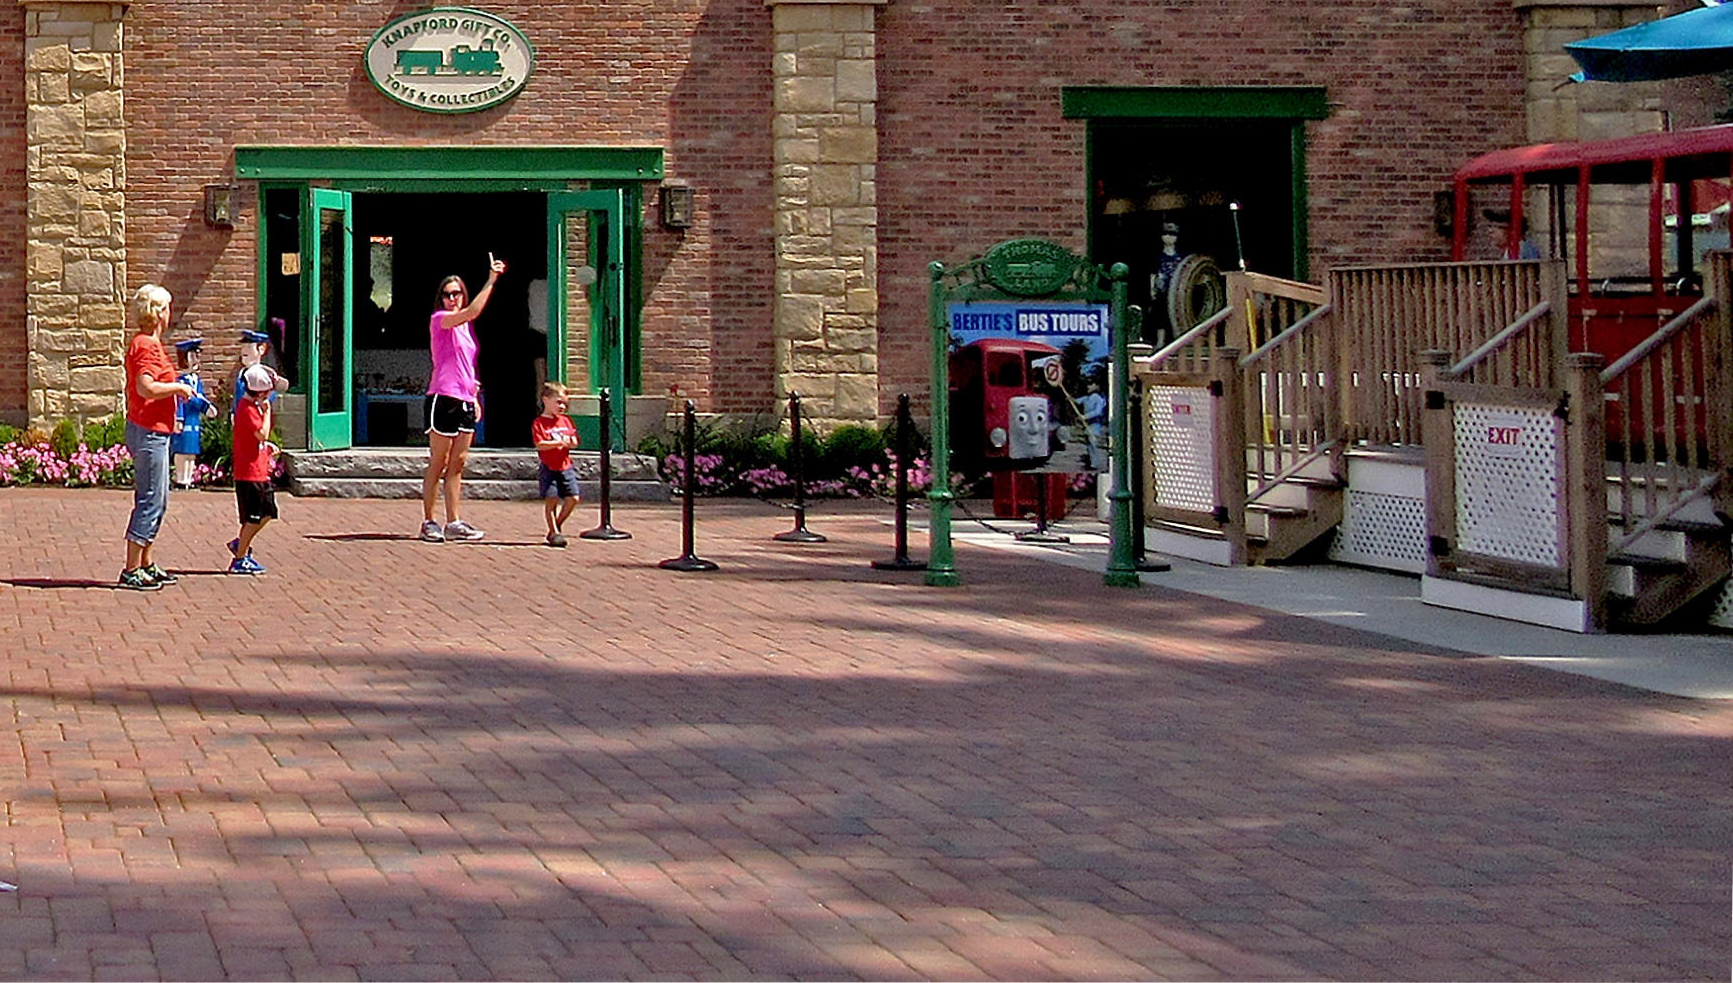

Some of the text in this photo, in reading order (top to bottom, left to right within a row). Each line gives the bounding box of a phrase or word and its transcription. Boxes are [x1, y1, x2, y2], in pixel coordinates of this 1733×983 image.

[380, 18, 458, 49] KNAPFORD
[461, 19, 493, 36] GIFT
[384, 74, 516, 105] TOYS & COLLECTIBLES
[953, 313, 1099, 332] BERTIE'S BUS TOURS
[1488, 427, 1520, 445] EXIT
